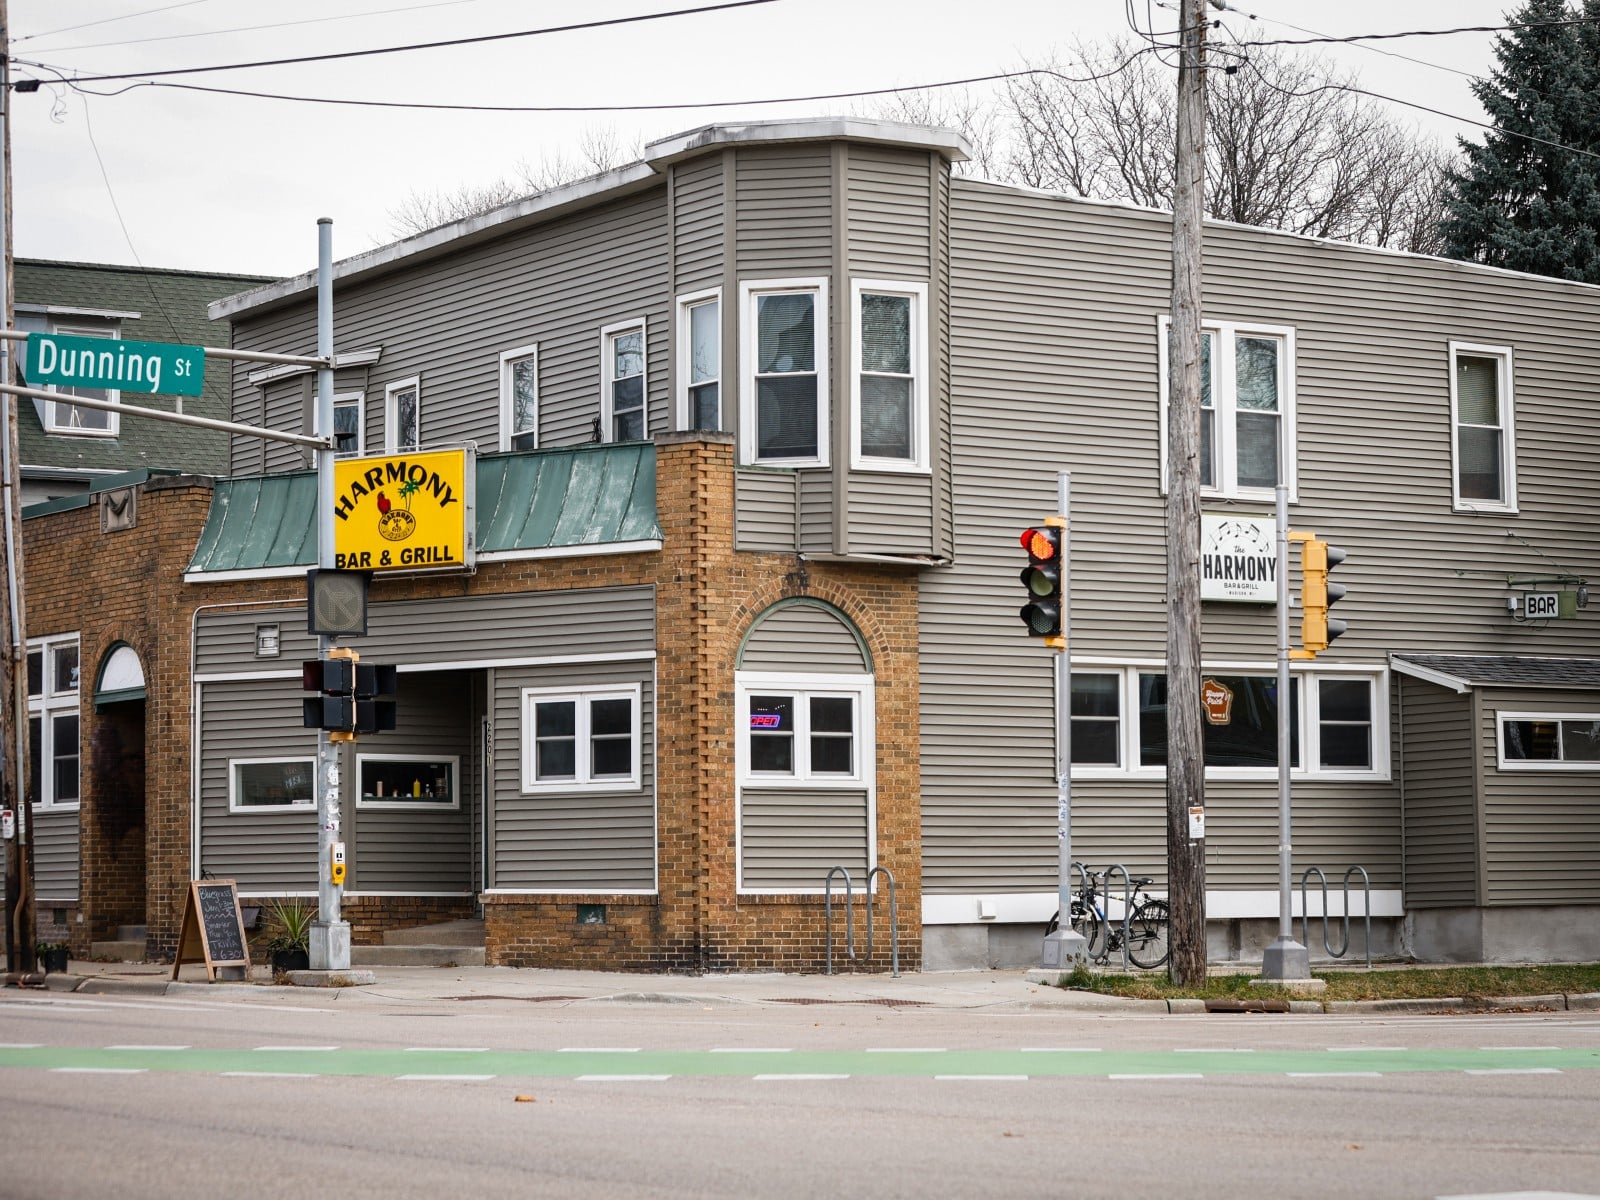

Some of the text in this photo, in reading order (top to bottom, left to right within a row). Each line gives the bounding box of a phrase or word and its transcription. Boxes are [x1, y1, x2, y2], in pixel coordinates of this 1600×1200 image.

[38, 339, 192, 394] Dunning St
[335, 462, 458, 521] HARMONY
[335, 545, 454, 569] BAR & GRILL
[1233, 545, 1246, 553] the
[1203, 554, 1277, 582] HARMONY
[1528, 596, 1556, 614] BAR
[751, 716, 778, 726] OPEN
